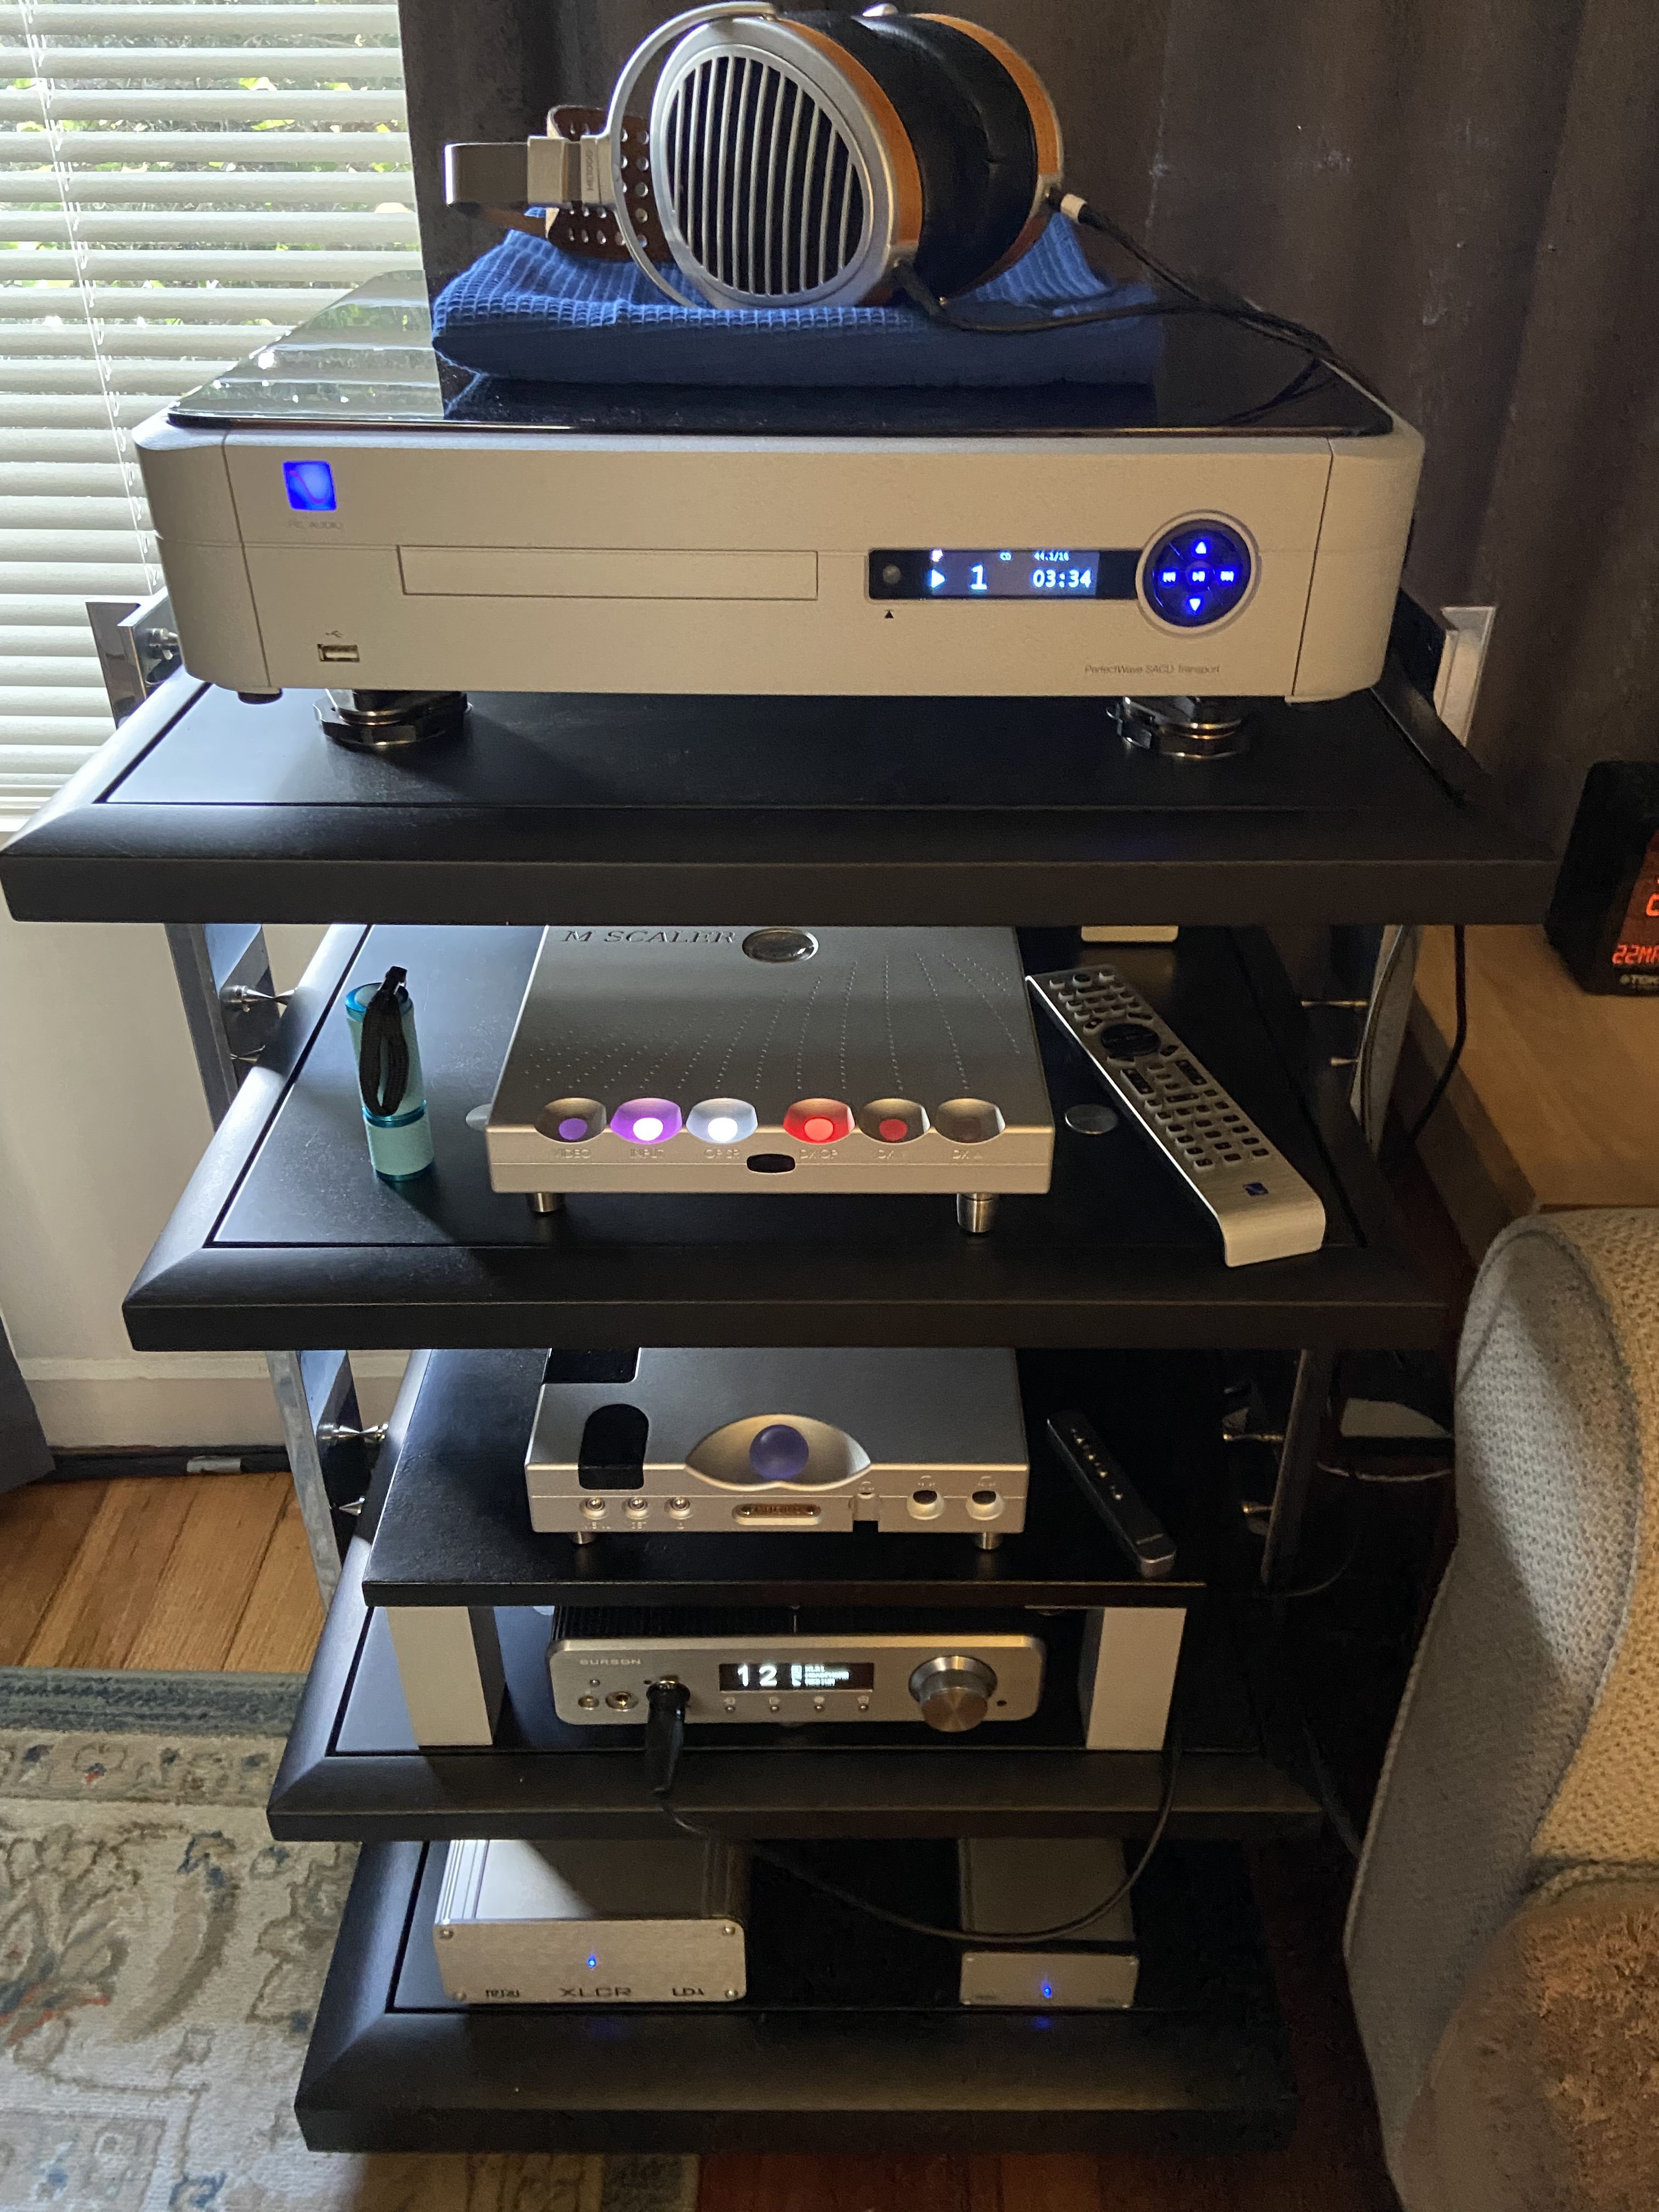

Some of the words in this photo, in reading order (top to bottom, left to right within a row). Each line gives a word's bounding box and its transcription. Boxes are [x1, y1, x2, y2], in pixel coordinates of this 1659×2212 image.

[970, 565, 988, 590] 1
[1032, 568, 1092, 589] 03:34
[561, 930, 593, 943] M
[603, 930, 736, 943] SCALER
